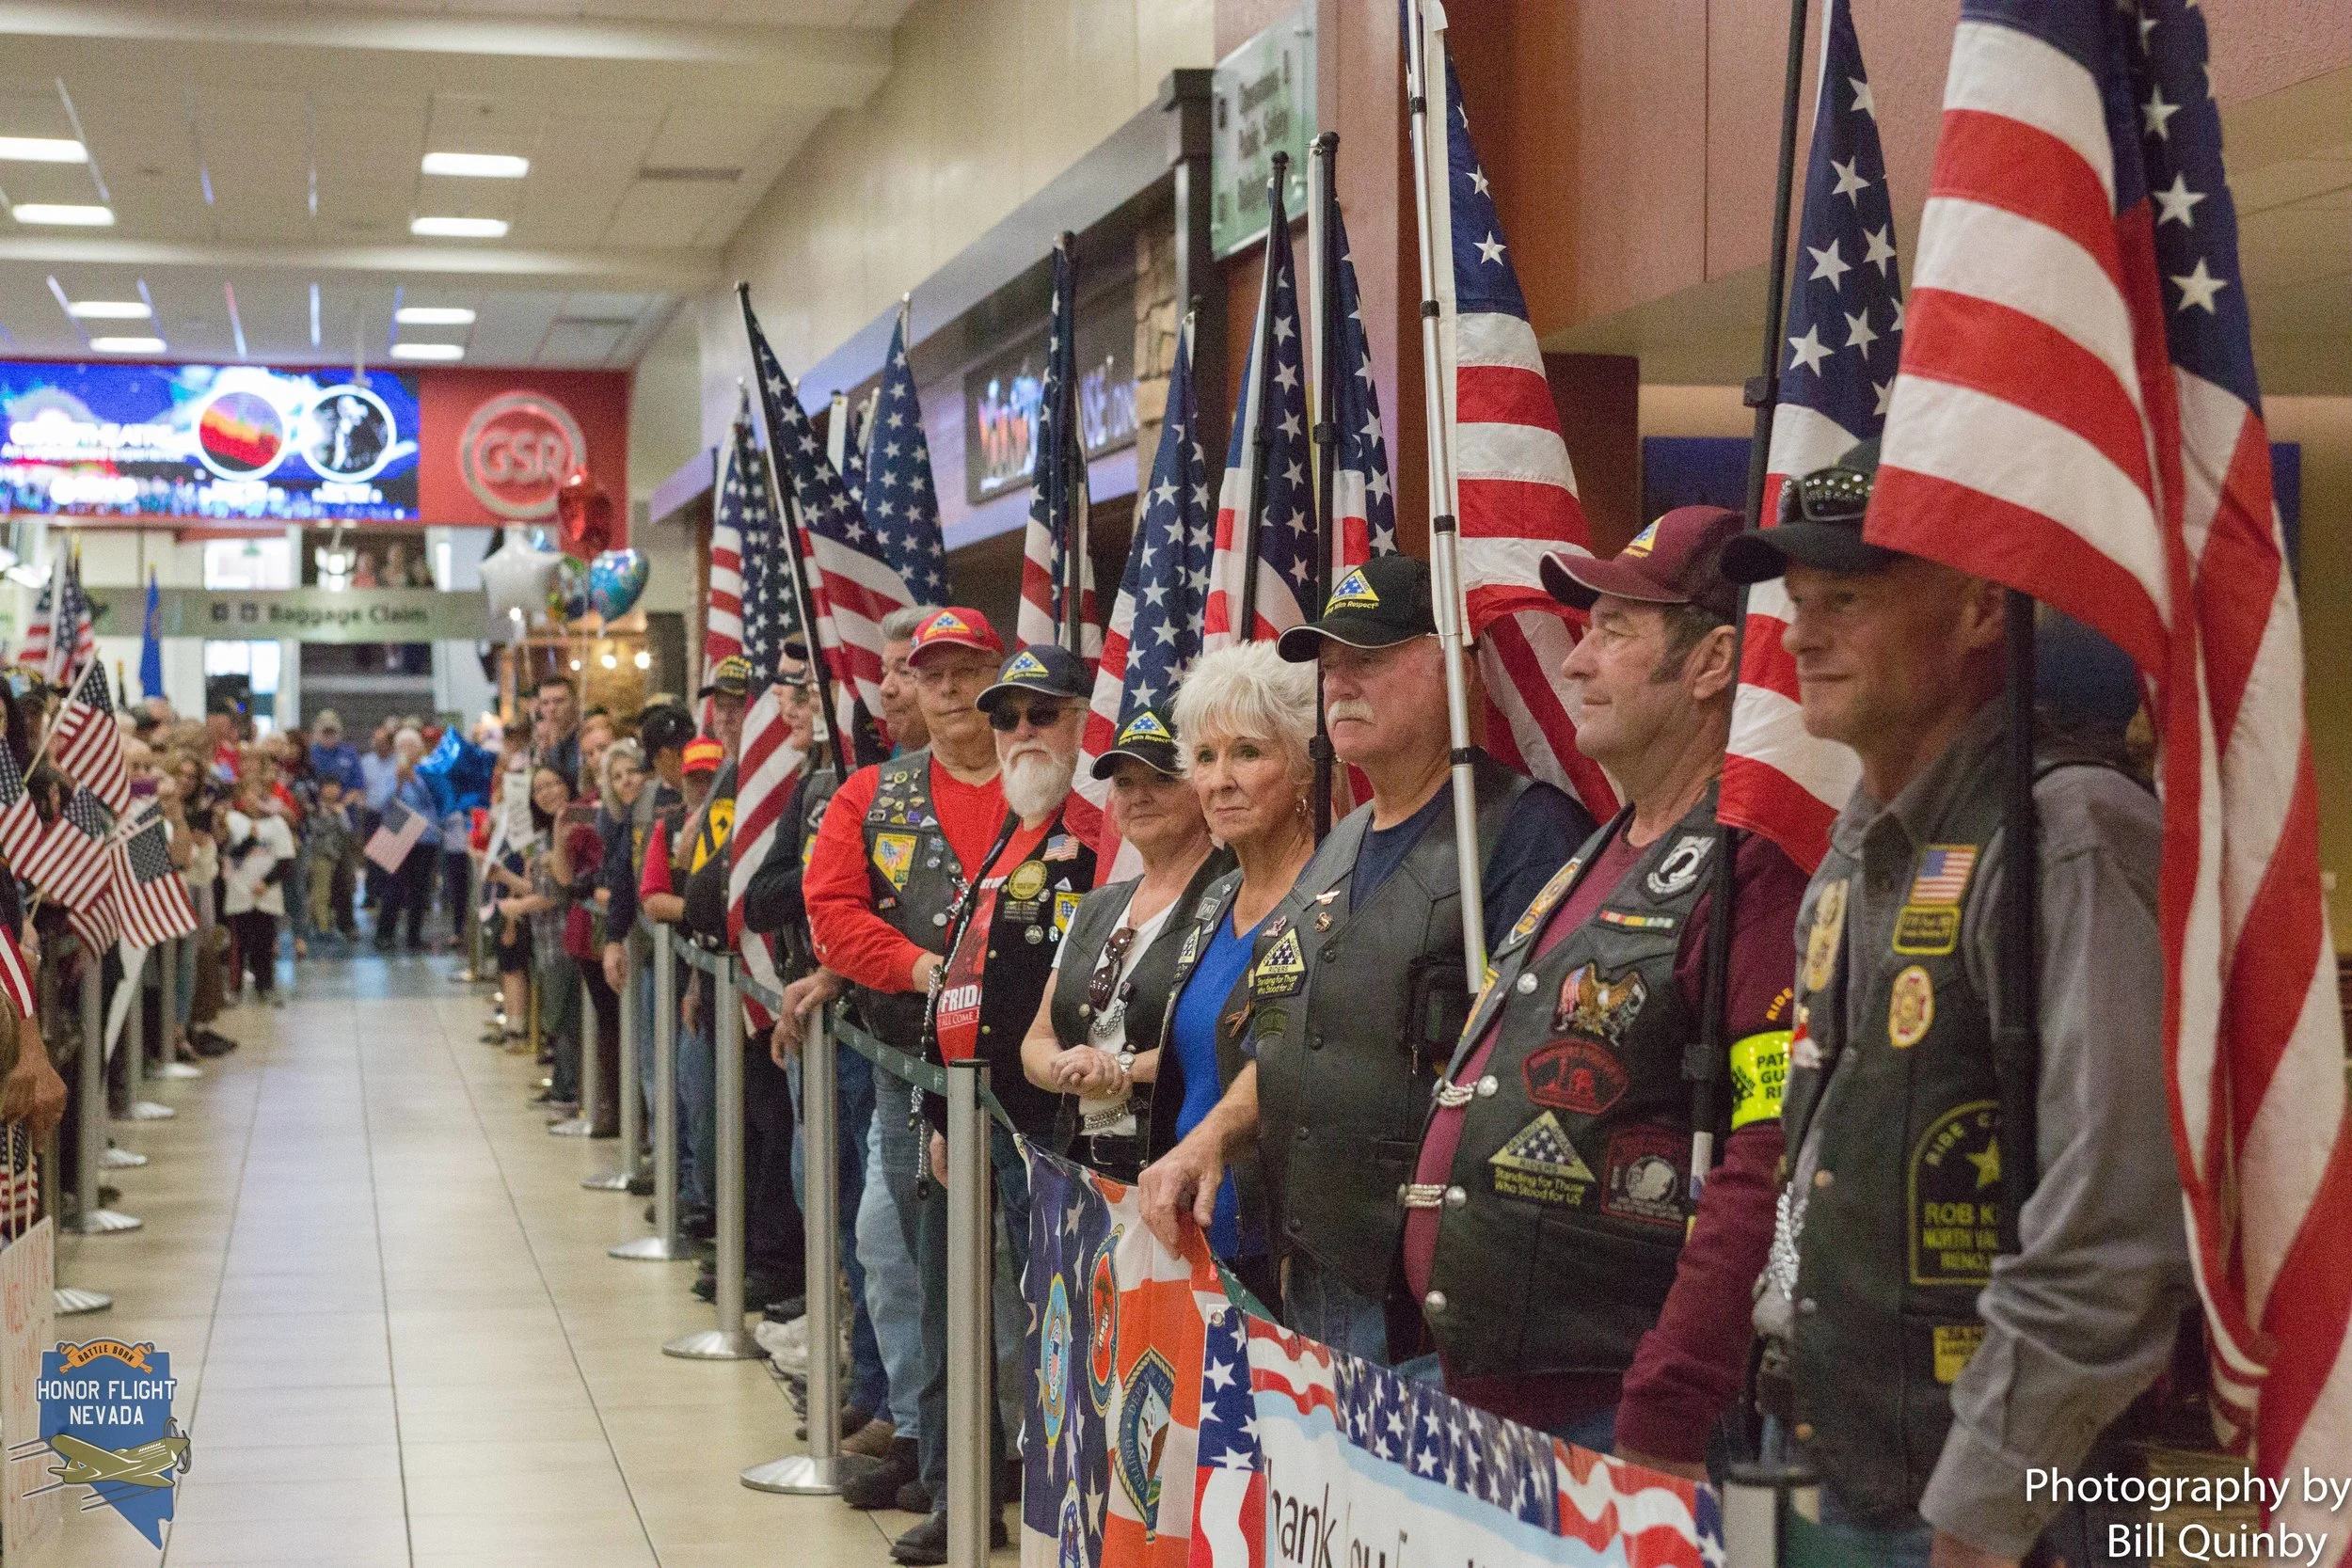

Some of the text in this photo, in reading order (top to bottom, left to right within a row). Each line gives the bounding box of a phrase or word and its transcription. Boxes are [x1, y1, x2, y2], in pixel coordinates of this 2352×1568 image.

[479, 430, 567, 483] GSR
[269, 603, 428, 626] Baggage Claim
[940, 984, 982, 1013] FRID
[1924, 1202, 1974, 1226] ROB
